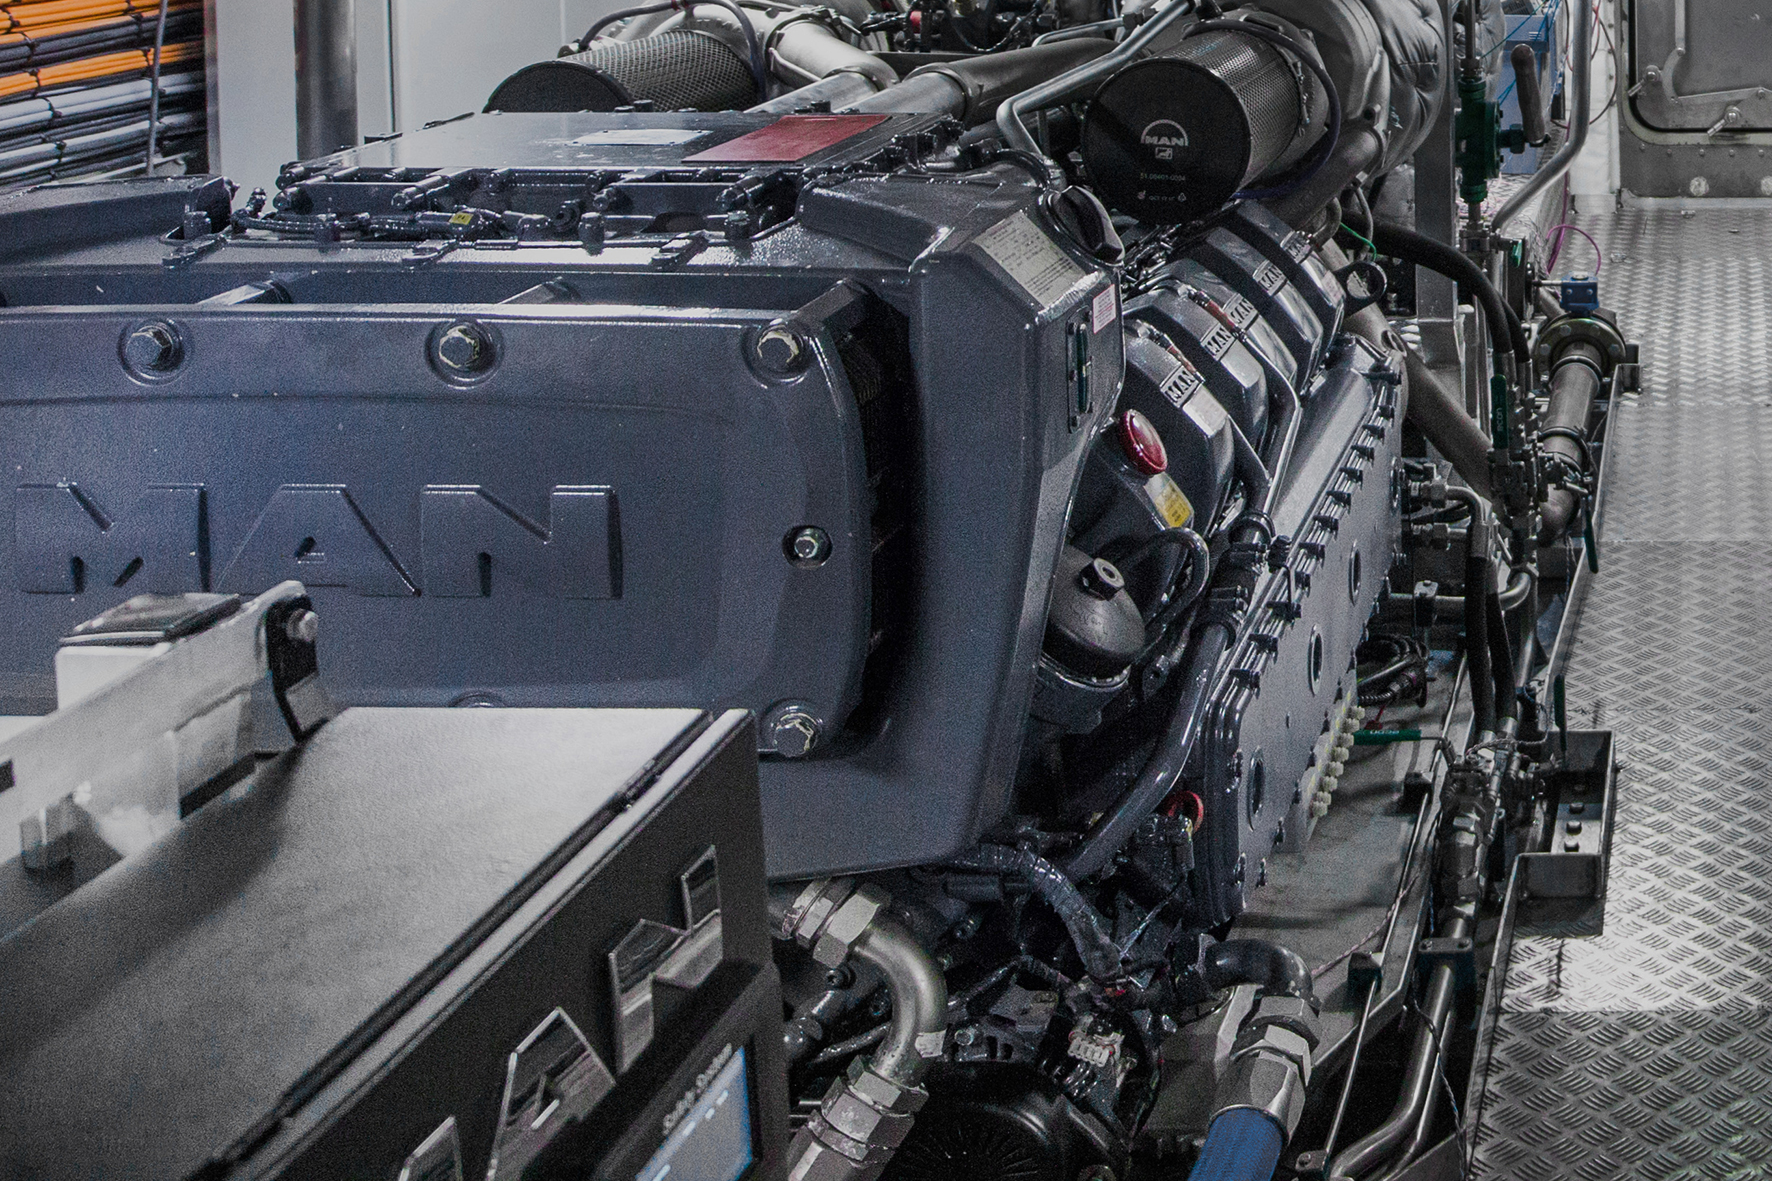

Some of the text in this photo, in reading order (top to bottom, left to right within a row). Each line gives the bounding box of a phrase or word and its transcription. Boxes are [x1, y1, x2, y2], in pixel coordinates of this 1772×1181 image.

[1145, 135, 1185, 147] MAN
[1258, 265, 1284, 291] MAN
[1204, 325, 1232, 357] MAN
[1165, 369, 1196, 404] MAN
[12, 483, 623, 599] MAN
